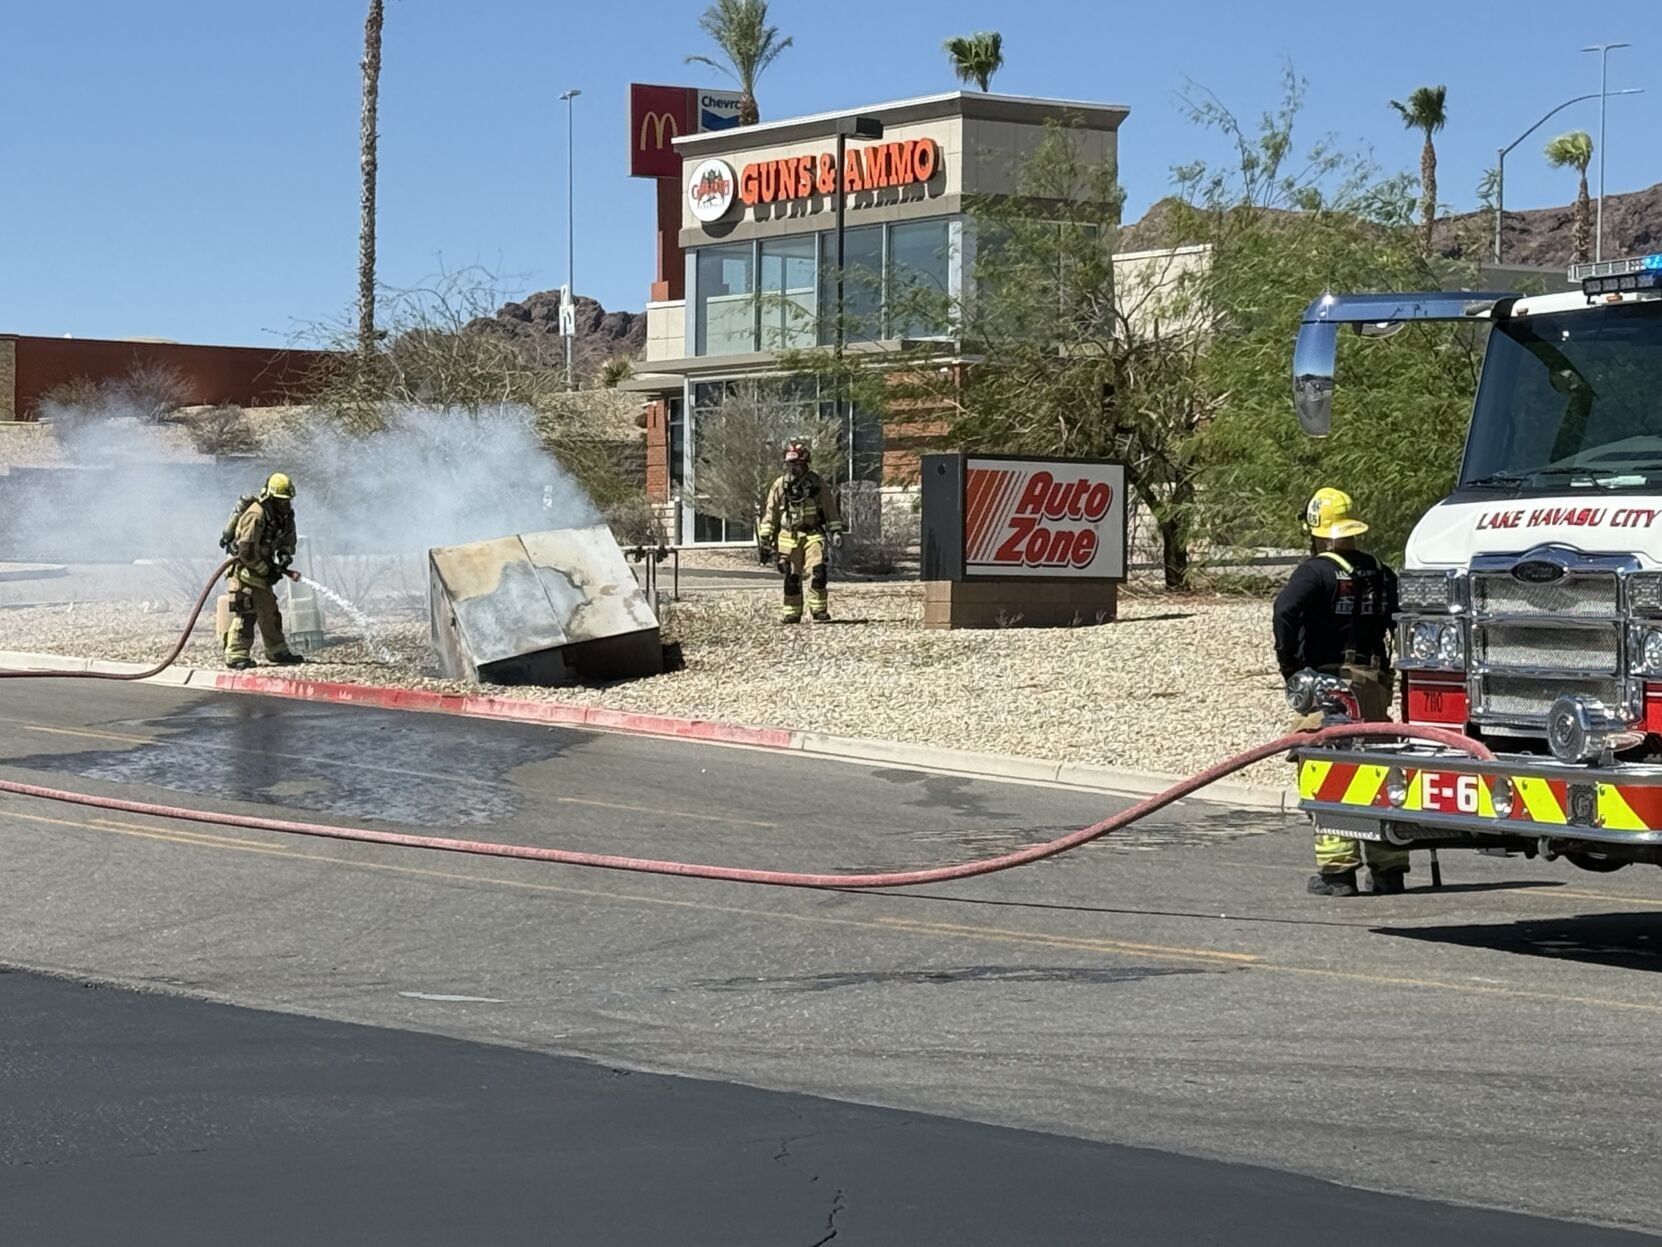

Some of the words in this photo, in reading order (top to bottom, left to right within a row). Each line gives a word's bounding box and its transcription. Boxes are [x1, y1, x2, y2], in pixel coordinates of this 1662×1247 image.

[701, 95, 742, 109] Chevro
[741, 155, 815, 206] GUNS
[818, 152, 836, 194] &
[844, 137, 937, 192] AMMO
[1015, 471, 1112, 520] Auto
[1475, 510, 1526, 530] LAKE
[1526, 507, 1608, 528] HAVASU
[1609, 508, 1662, 528] CITY
[994, 517, 1099, 567] Zone
[1422, 773, 1478, 812] E-6
